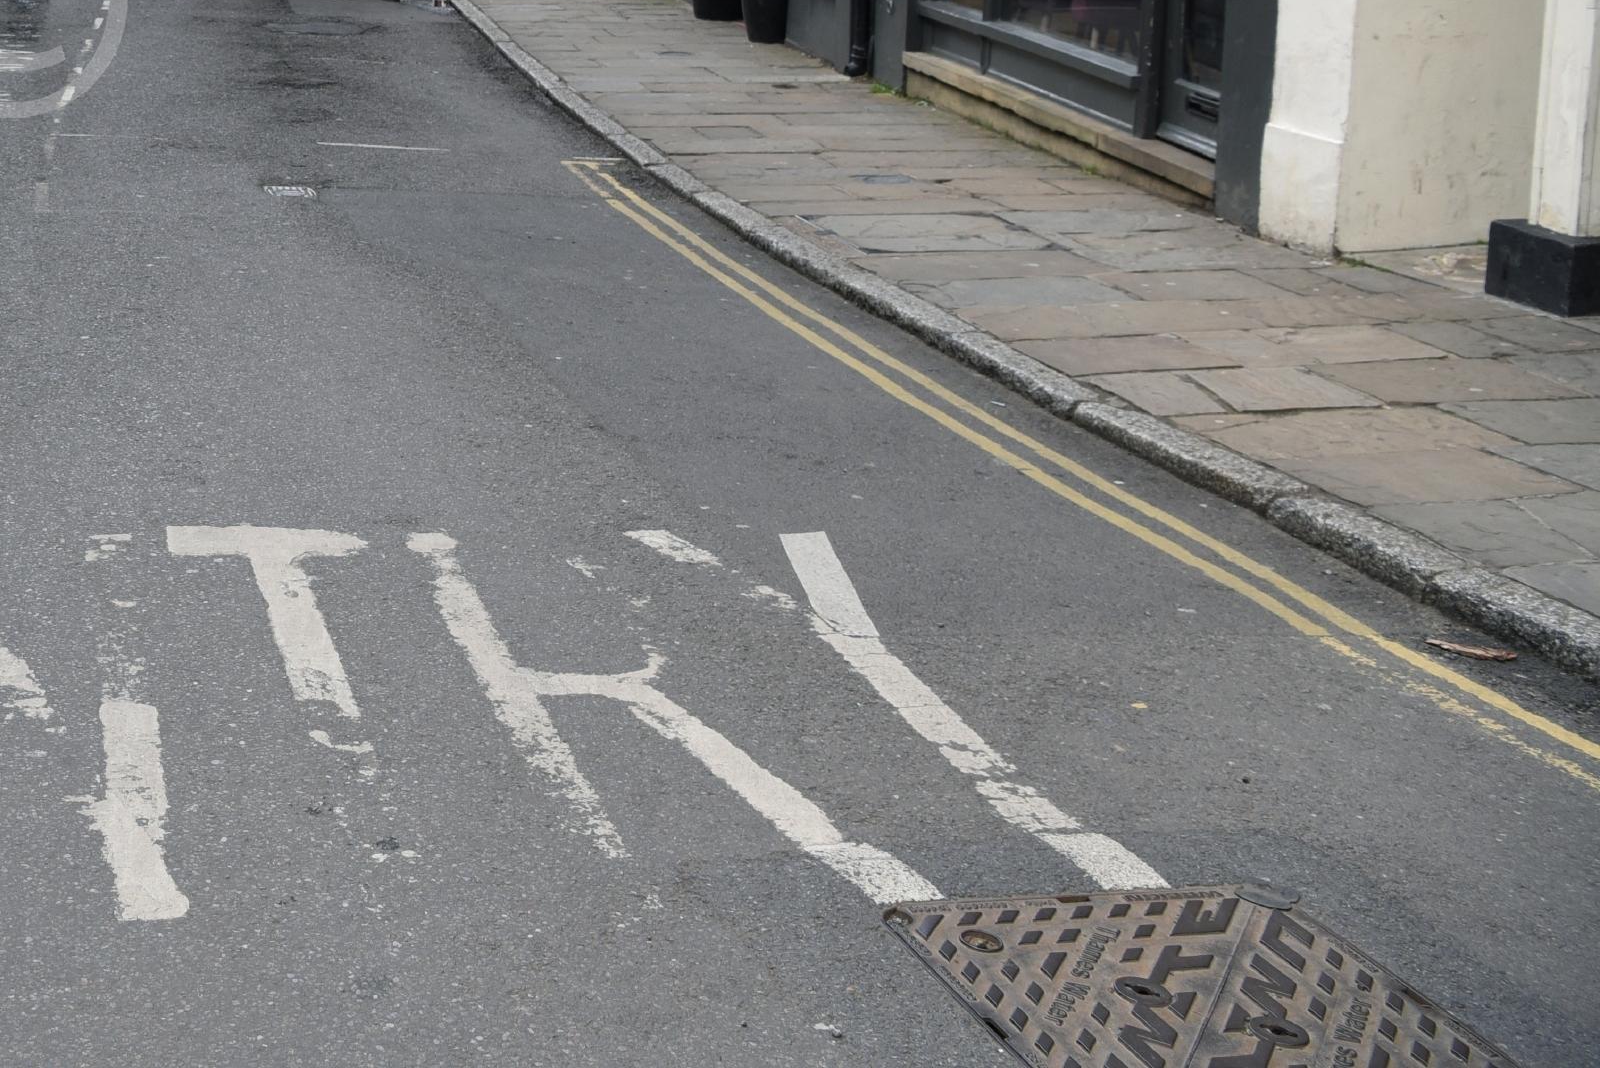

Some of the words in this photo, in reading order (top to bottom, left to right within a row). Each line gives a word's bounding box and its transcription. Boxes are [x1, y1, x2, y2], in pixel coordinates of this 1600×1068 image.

[1070, 925, 1121, 979] Thames
[1044, 982, 1091, 1027] Water
[1332, 996, 1373, 1044] Water
